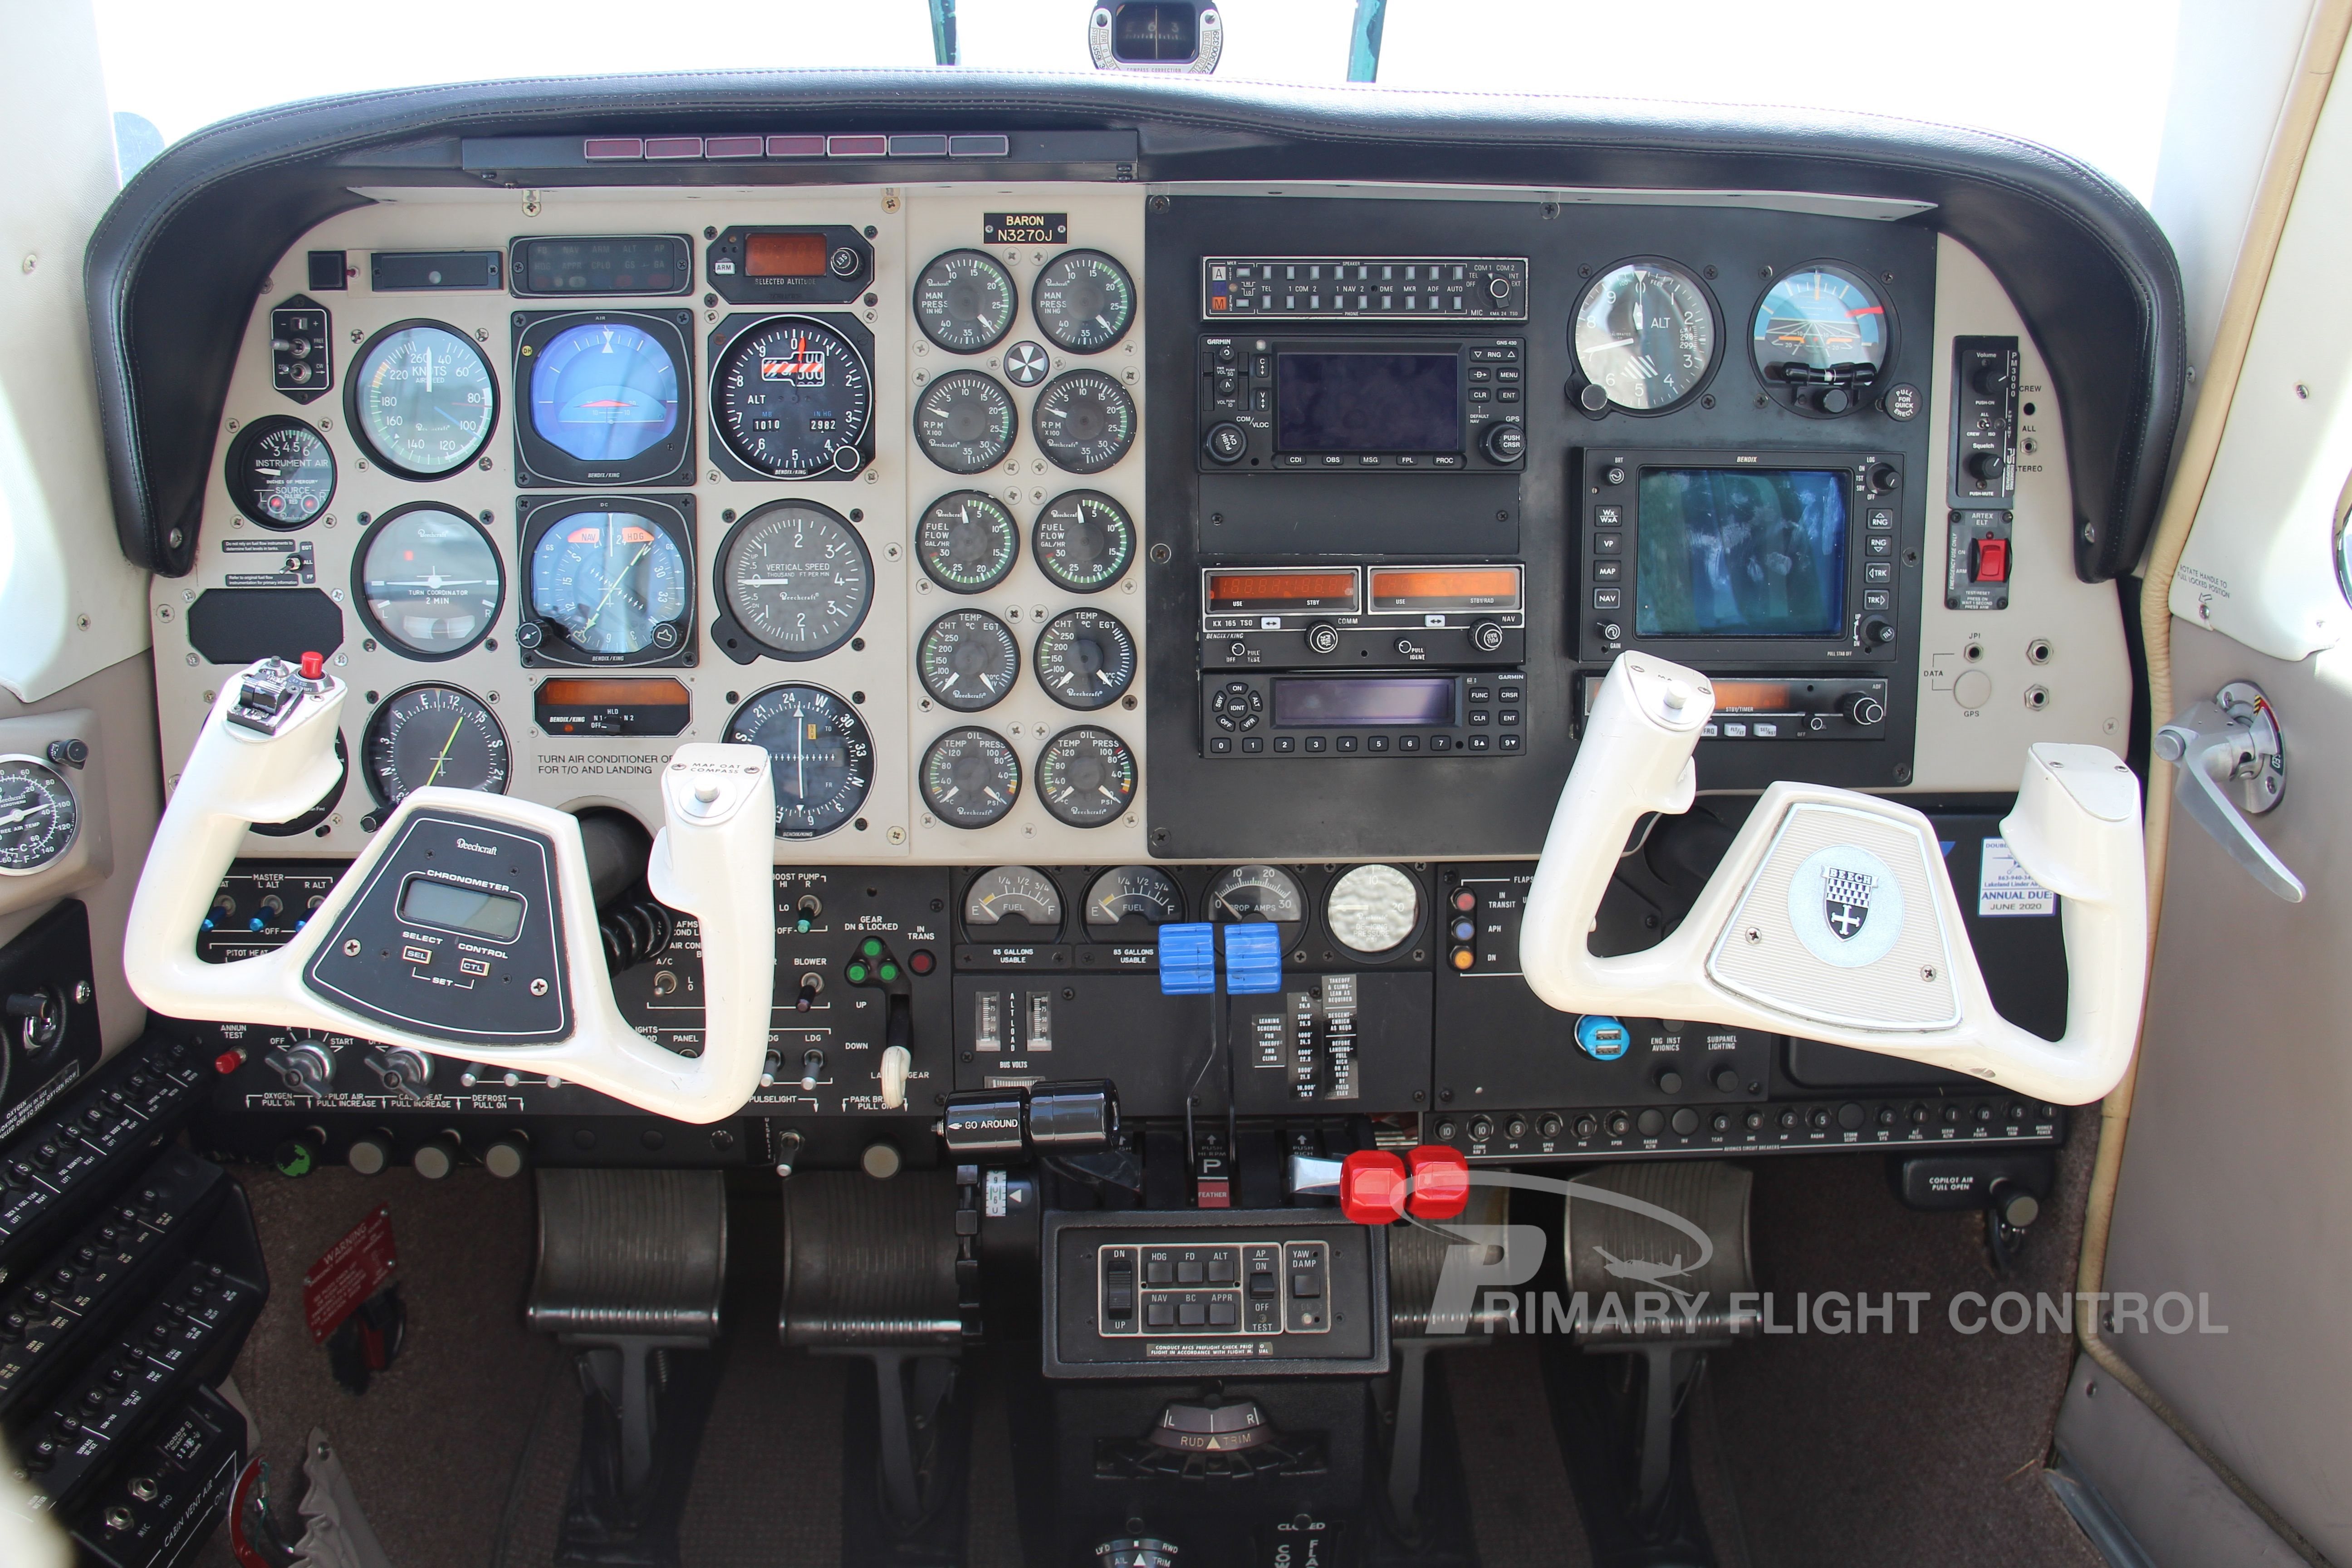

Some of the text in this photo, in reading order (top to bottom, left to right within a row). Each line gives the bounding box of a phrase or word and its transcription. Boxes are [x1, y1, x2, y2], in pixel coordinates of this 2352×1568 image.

[1006, 216, 1044, 226] BARON
[998, 229, 1052, 241] N3270J
[1651, 317, 1671, 328] ALT
[390, 369, 408, 380] 220
[456, 367, 469, 377] 60
[1896, 389, 1912, 397] PULL
[747, 395, 766, 404] ALT
[1894, 408, 1913, 417] ERECT
[811, 420, 836, 430] 2982
[983, 622, 999, 631] EGT
[1215, 695, 1223, 708] SBY
[538, 755, 565, 763] TURN
[587, 755, 658, 763] CONDITIONER
[561, 766, 578, 774] T/O
[606, 766, 652, 774] LANDING
[456, 838, 497, 856] Beechcraft
[426, 869, 510, 892] CHRONOMETER
[1829, 868, 1872, 884] BEECH
[1981, 891, 2053, 900] ANNUAL DUE:
[402, 931, 443, 945] SELECT
[458, 943, 508, 959] CONTROL
[432, 977, 453, 986] SET
[749, 1095, 798, 1103] PULSELIGHT
[965, 1119, 1018, 1129] GO AROUND
[1293, 1250, 1309, 1258] YAW
[1293, 1259, 1316, 1268] DAMP
[1181, 1436, 1204, 1447] RUD
[159, 1494, 172, 1509] PHO
[164, 1479, 212, 1547] CABIN VENT AIR
[137, 1523, 151, 1538] MIC
